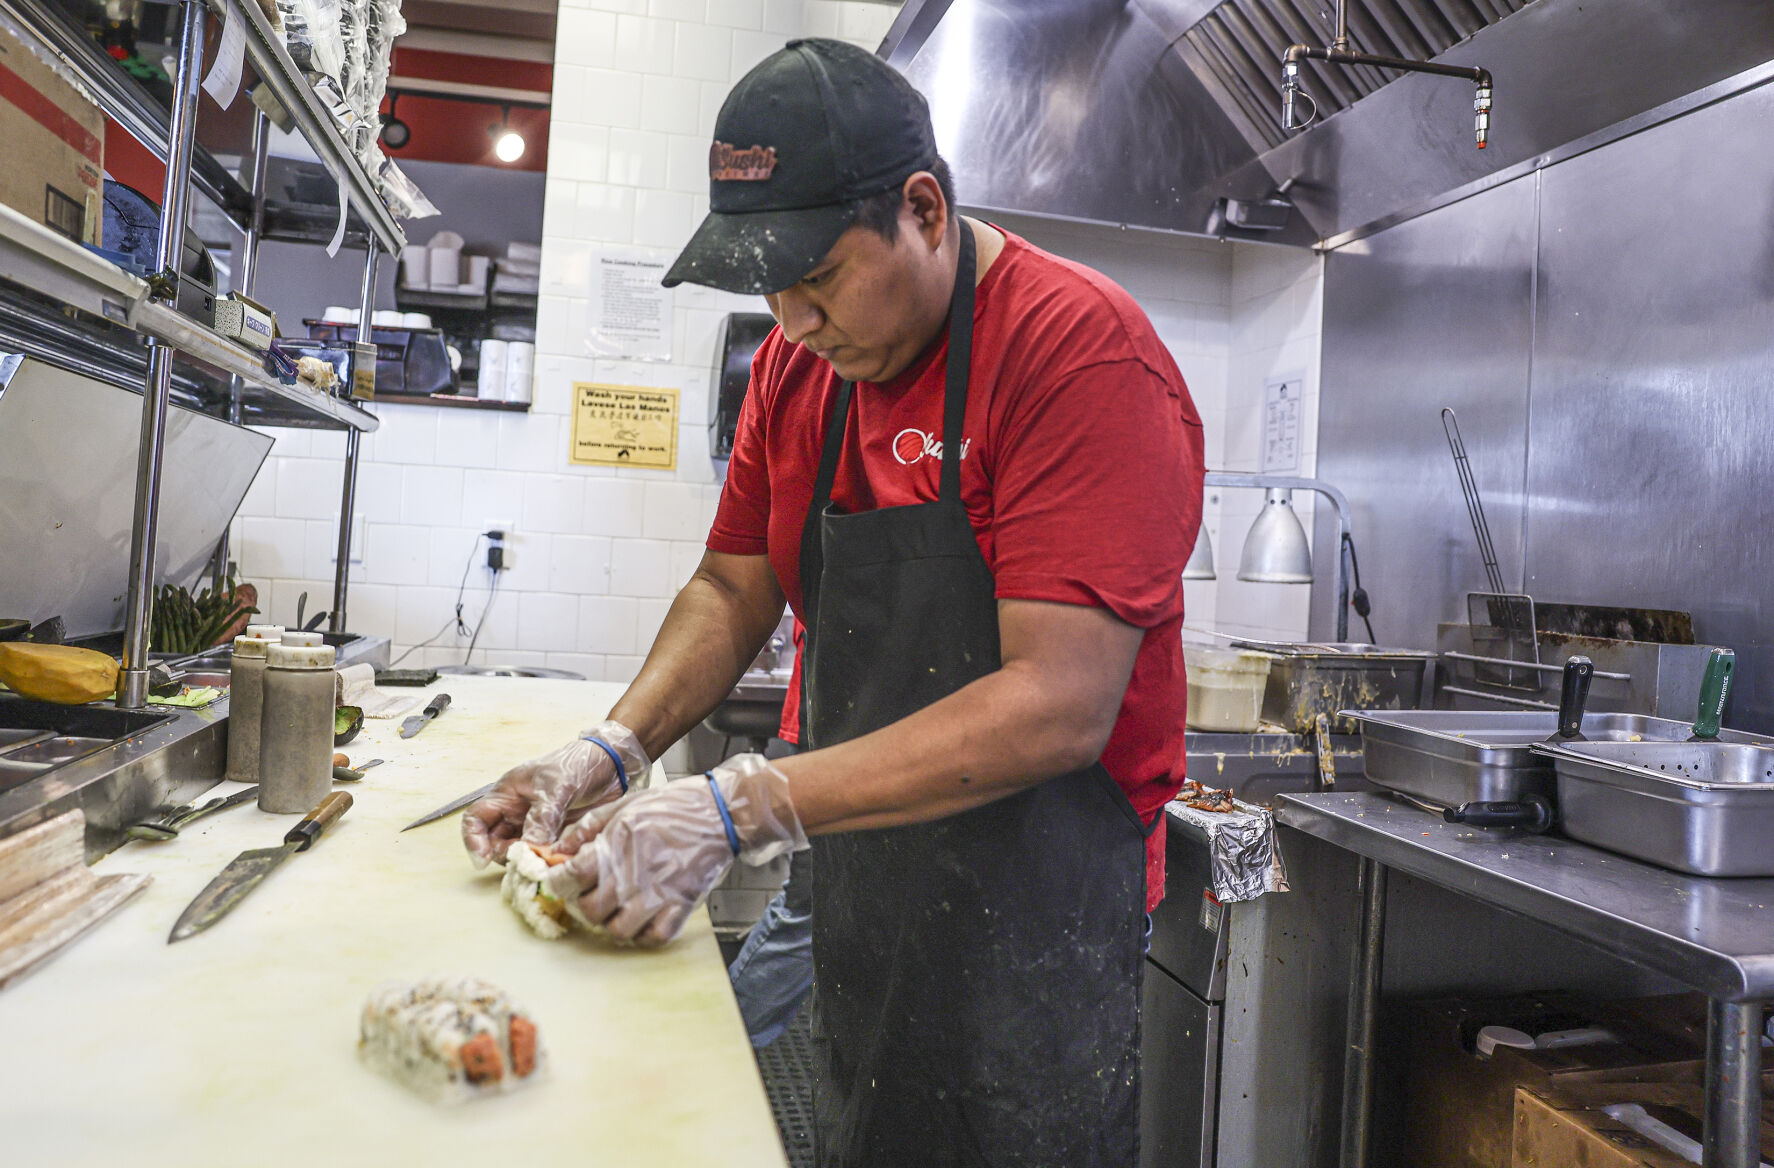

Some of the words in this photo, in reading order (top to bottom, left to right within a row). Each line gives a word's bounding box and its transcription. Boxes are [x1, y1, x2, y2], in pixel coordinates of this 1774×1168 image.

[586, 390, 612, 398] Wash
[639, 394, 667, 403] hands
[639, 404, 670, 413] Manos
